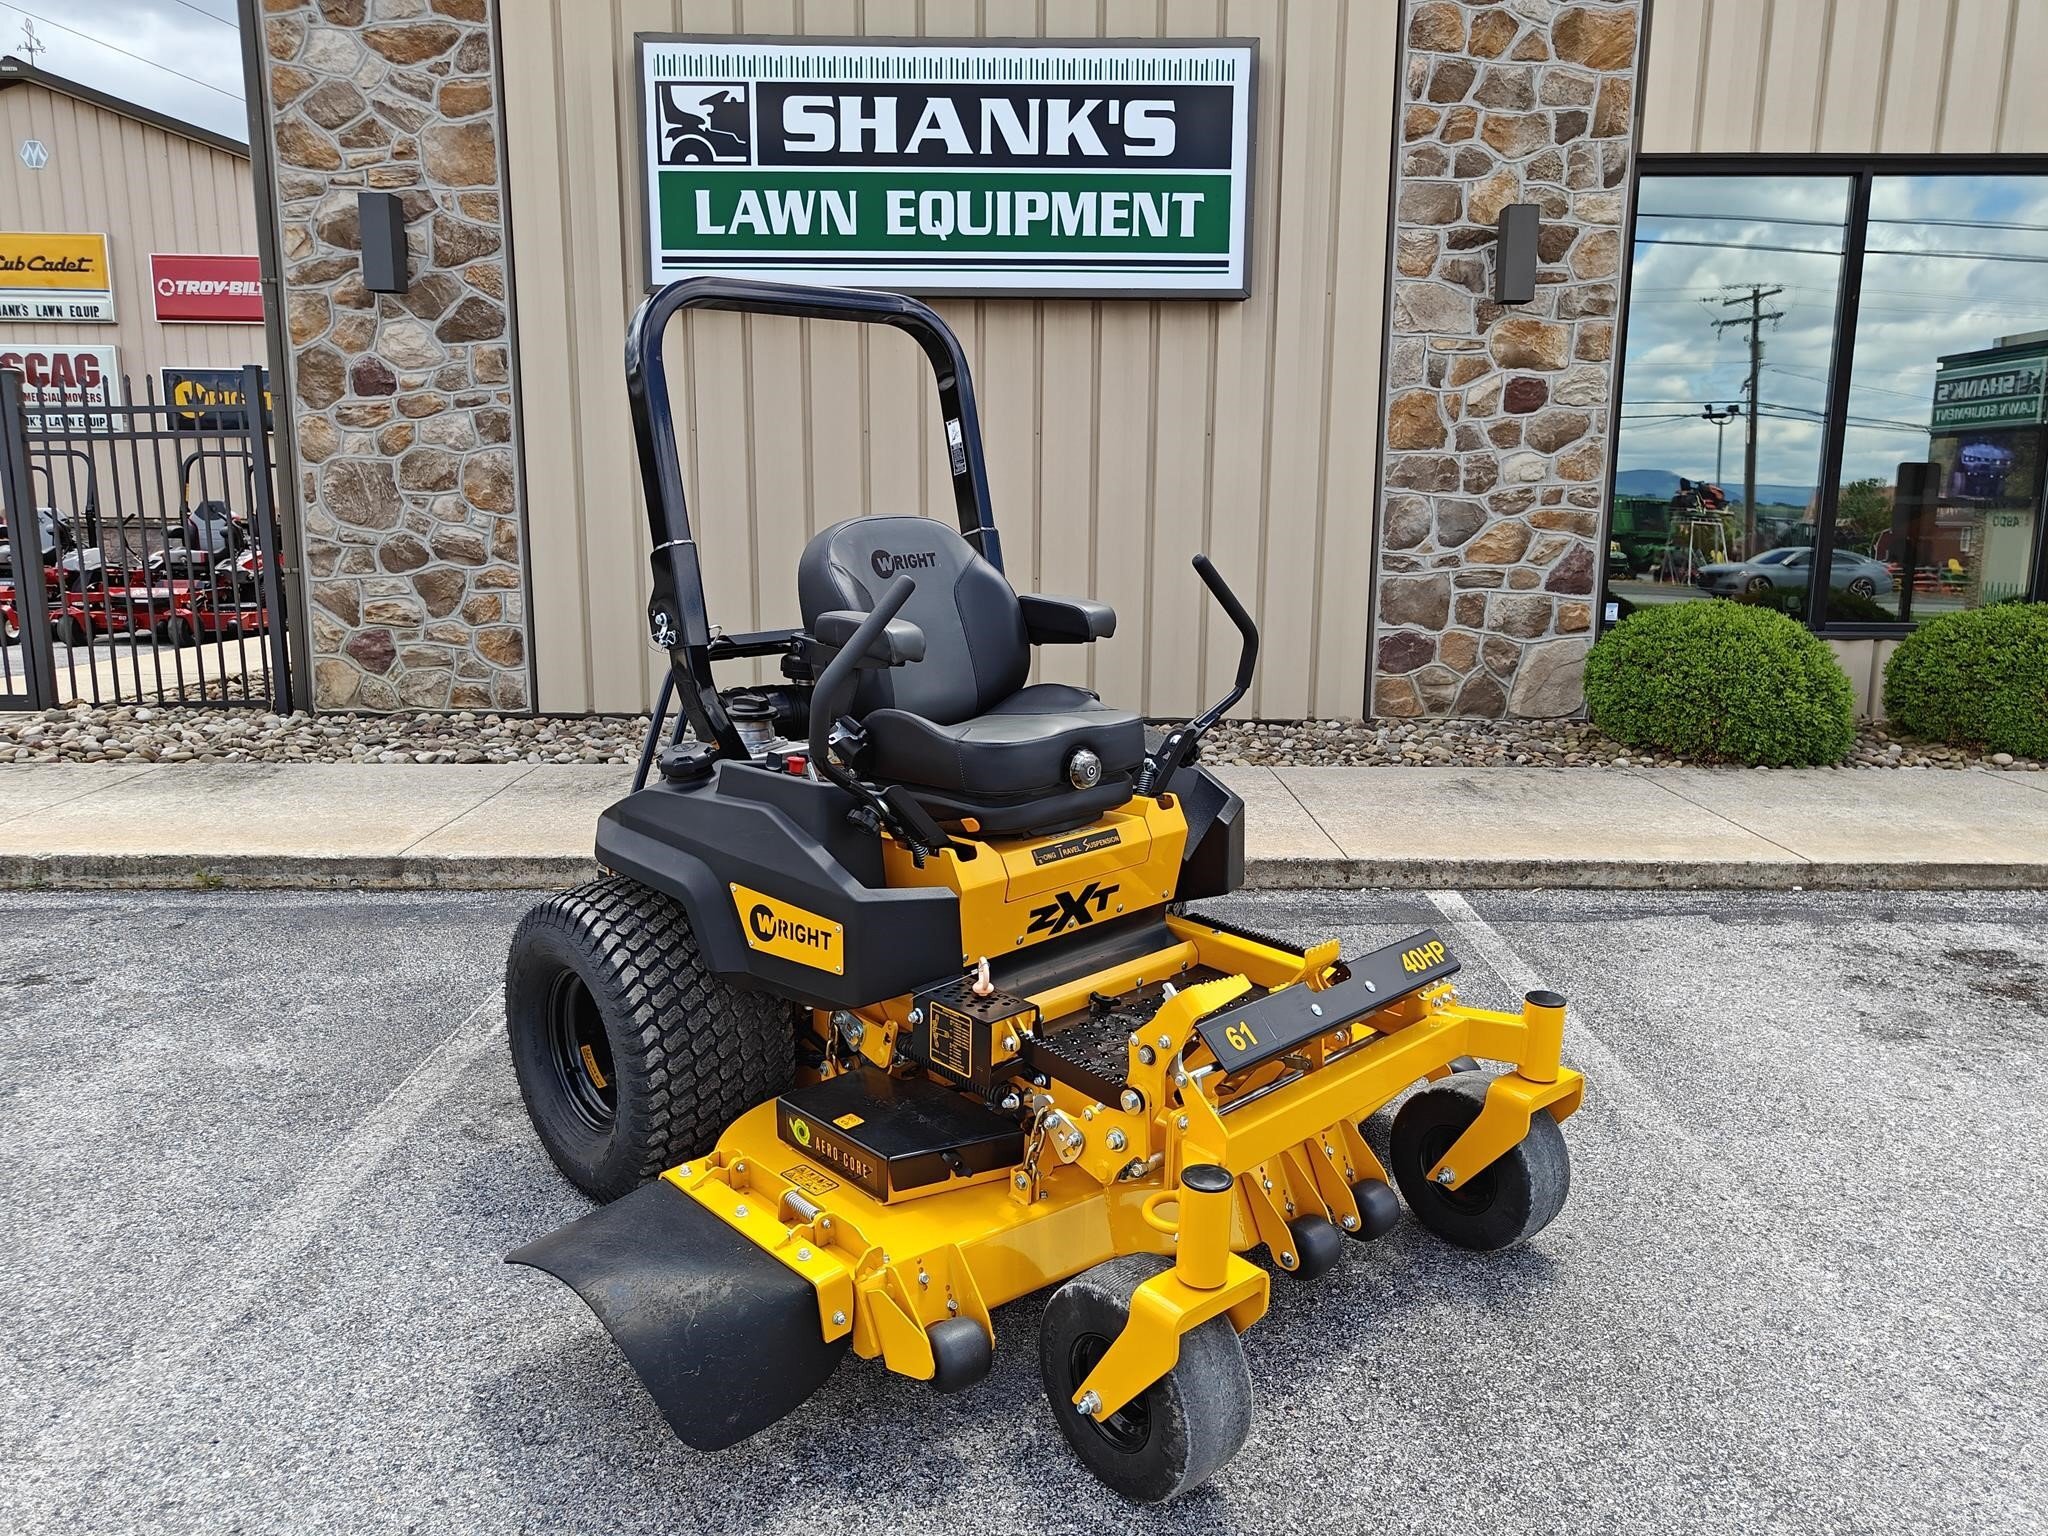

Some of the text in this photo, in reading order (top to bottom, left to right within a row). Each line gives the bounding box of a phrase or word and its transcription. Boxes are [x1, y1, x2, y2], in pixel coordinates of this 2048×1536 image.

[782, 95, 1176, 156] SHANK'S
[695, 189, 1205, 241] LAWN EQUIPMENT
[28, 256, 93, 272] Cadet
[0, 304, 29, 317] ANK'S
[36, 305, 63, 317] LAWN
[871, 550, 936, 579] WRIGHT
[1082, 838, 1120, 852] SUSPENSION
[750, 904, 832, 950] WRIGHT
[1401, 940, 1445, 973] 40HP
[1225, 1020, 1259, 1051] 61
[815, 1136, 868, 1179] AERO CORE
